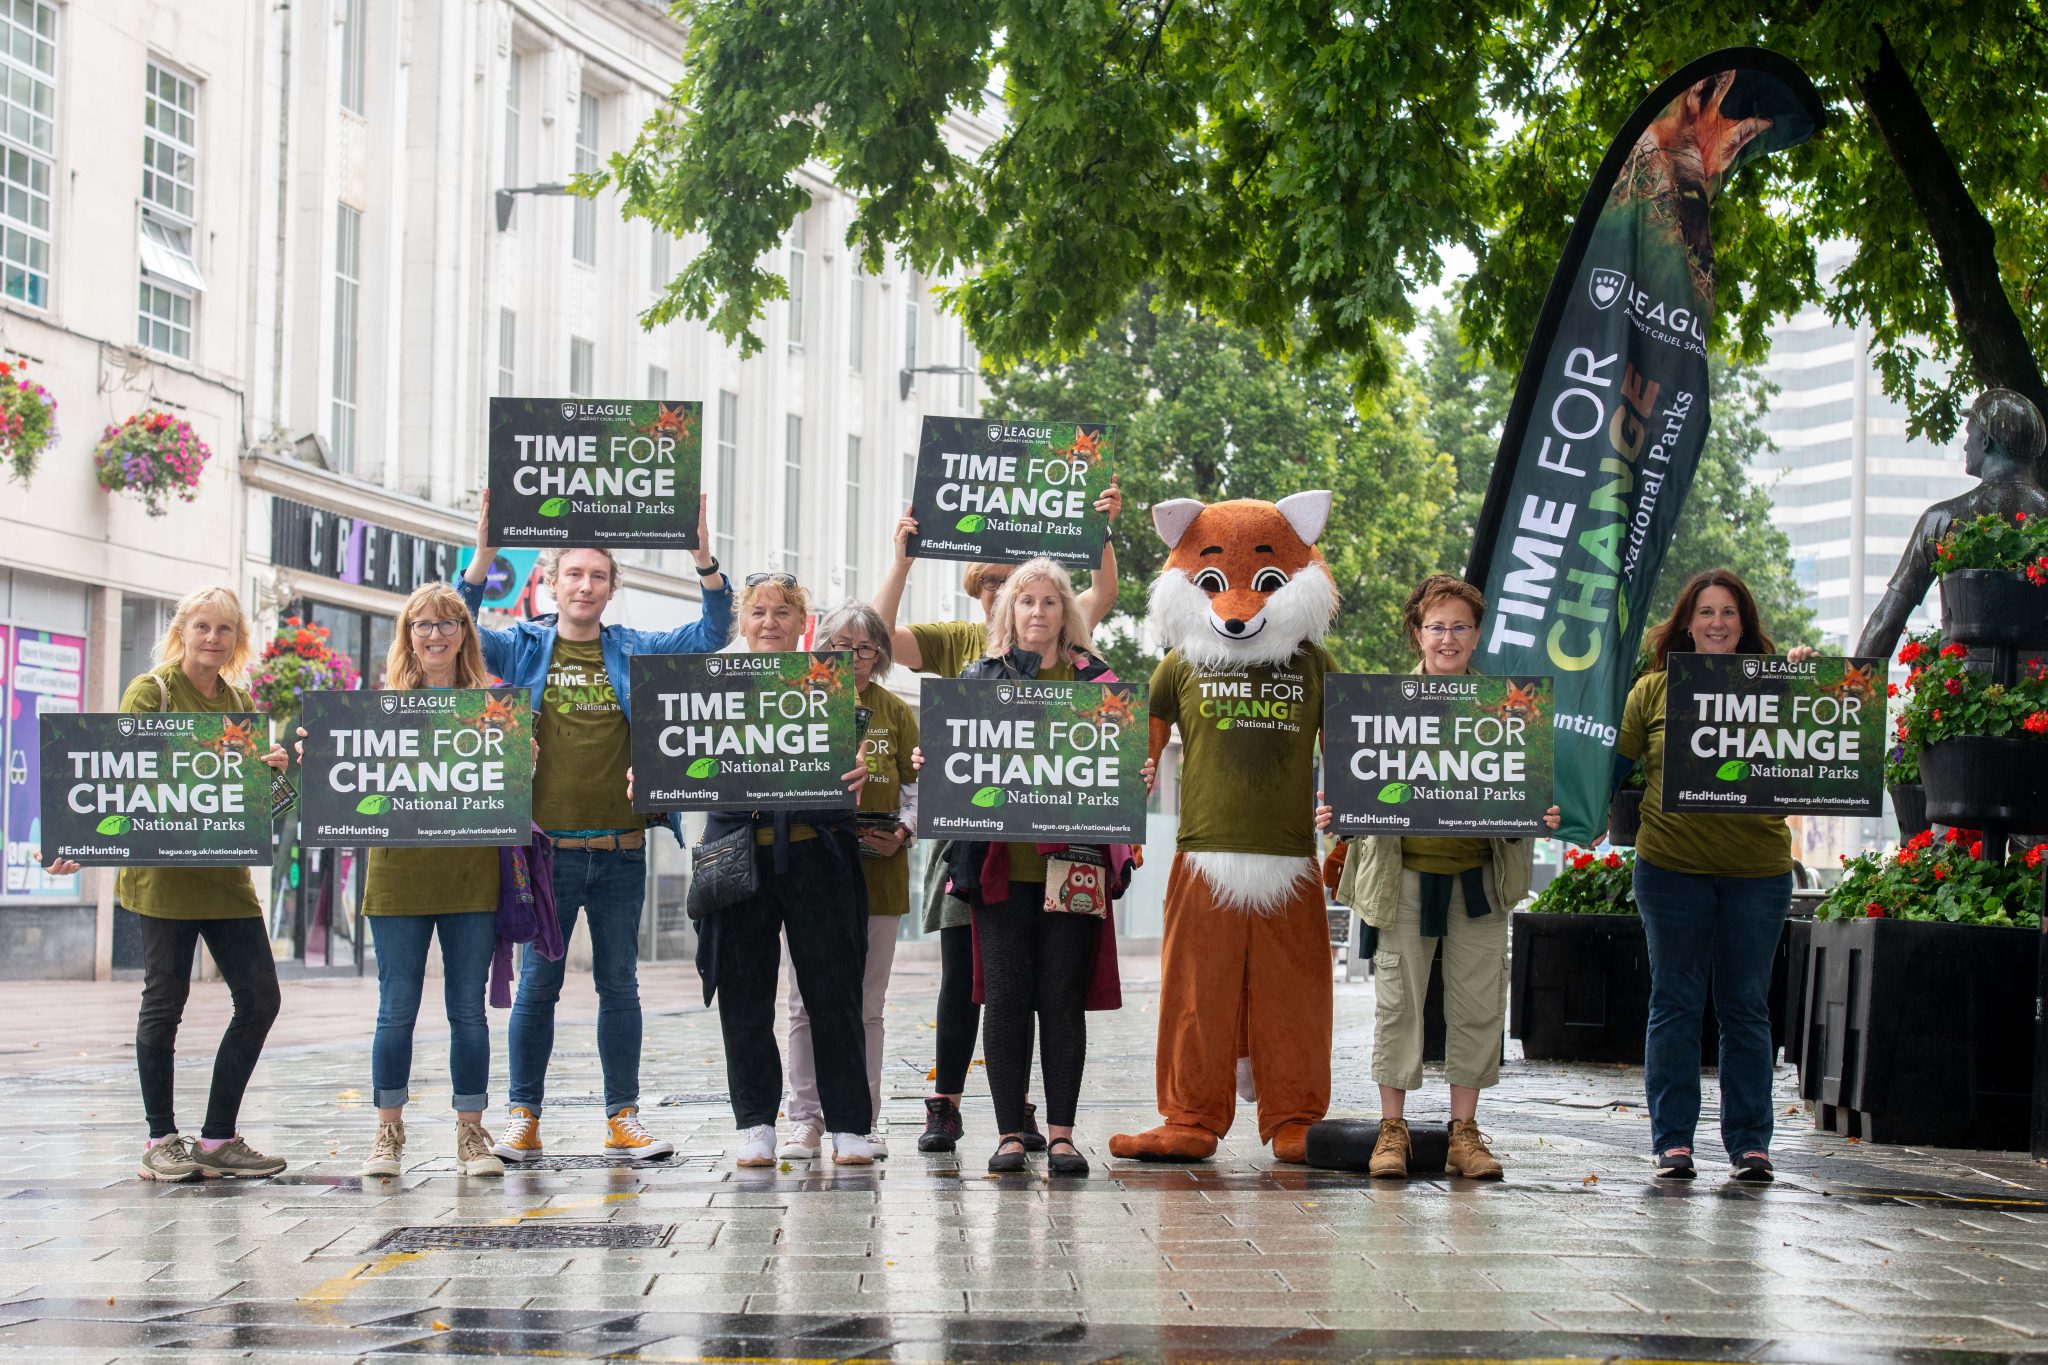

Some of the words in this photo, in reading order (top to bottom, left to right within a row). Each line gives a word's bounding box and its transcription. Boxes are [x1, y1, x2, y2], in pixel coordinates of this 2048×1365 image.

[1628, 281, 1706, 350] LEAGU
[1651, 330, 1681, 347] CRUEL
[579, 404, 632, 415] LEAGUE
[1003, 426, 1052, 438] LEAGUE
[514, 435, 597, 462] TIME
[610, 436, 676, 464] FOR
[942, 453, 1016, 482] TIME
[1027, 458, 1088, 486] FOR
[513, 466, 676, 498] CHANGE
[1624, 469, 1664, 582] National
[1649, 392, 1693, 464] Parks
[936, 483, 1085, 518] CHANGE
[1488, 494, 1577, 654] TIME
[1538, 348, 1618, 478] FOR
[571, 501, 632, 514] National
[636, 502, 675, 515] Parks
[1547, 362, 1660, 672] CHANGE
[502, 526, 568, 538] #EndHunting
[986, 518, 1042, 533] National
[1047, 524, 1082, 536] Parks
[595, 531, 685, 539] league.org.uk/nationalparks
[310, 511, 446, 590] CREAMS
[921, 540, 981, 554] #EndHunting
[1005, 548, 1090, 559] league.org.uk/nationalparks
[725, 657, 780, 670] LEAGUE
[1762, 661, 1816, 673] LEAGUE
[546, 672, 588, 686] TIME
[544, 686, 618, 702] CHANG
[1016, 686, 1073, 699] LEAGUE
[1199, 682, 1252, 698] TIME
[1261, 684, 1304, 702] FOR
[1421, 682, 1477, 694] LEAGUE
[400, 696, 456, 707] LEAGUE
[658, 692, 745, 721] TIME
[760, 690, 828, 719] FOR
[1200, 700, 1303, 720] CHANGE
[1694, 694, 1778, 723] TIME
[1792, 696, 1862, 725] FOR
[137, 719, 194, 730] LEAGUE
[1236, 720, 1275, 728] National
[1278, 722, 1300, 732] Parks
[1351, 715, 1440, 745] TIME
[1455, 717, 1526, 746] FOR
[330, 729, 419, 757] TIME
[434, 728, 504, 757] FOR
[658, 723, 829, 757] CHANGE
[945, 719, 1035, 749] TIME
[1049, 721, 1120, 752] FOR
[865, 740, 889, 754] OR
[1690, 726, 1860, 761] CHANGE
[68, 752, 158, 778] TIME
[173, 752, 243, 779] FOR
[721, 759, 785, 774] National
[789, 759, 830, 772] Parks
[944, 752, 1120, 788] CHANGE
[1350, 749, 1526, 783] CHANGE
[1750, 764, 1814, 779] National
[1818, 766, 1859, 780] Parks
[329, 761, 505, 793] CHANGE
[869, 774, 890, 784] Parks
[68, 783, 244, 813] CHANGE
[649, 789, 718, 801] #EndHunting
[747, 789, 842, 799] league.org.uk/nationalparks
[1007, 790, 1073, 805] National
[1077, 792, 1119, 806] Parks
[1413, 786, 1479, 800] National
[1483, 788, 1525, 801] Parks
[1678, 790, 1747, 804] #EndHunting
[392, 797, 458, 810] National
[462, 797, 504, 810] Parks
[1774, 796, 1869, 806] league.org.uk/nationalparks
[132, 818, 198, 831] National
[203, 819, 245, 831] Parks
[932, 817, 1004, 830] #EndHunting
[1339, 814, 1410, 826] #EndHunting
[1439, 818, 1538, 828] league.org.uk/nationalparks
[317, 826, 389, 837] #EndHunting
[418, 828, 517, 836] league.org.uk/nationalparks
[1032, 823, 1131, 833] league.org.uk/nationalparks
[58, 846, 130, 857] #EndHunting
